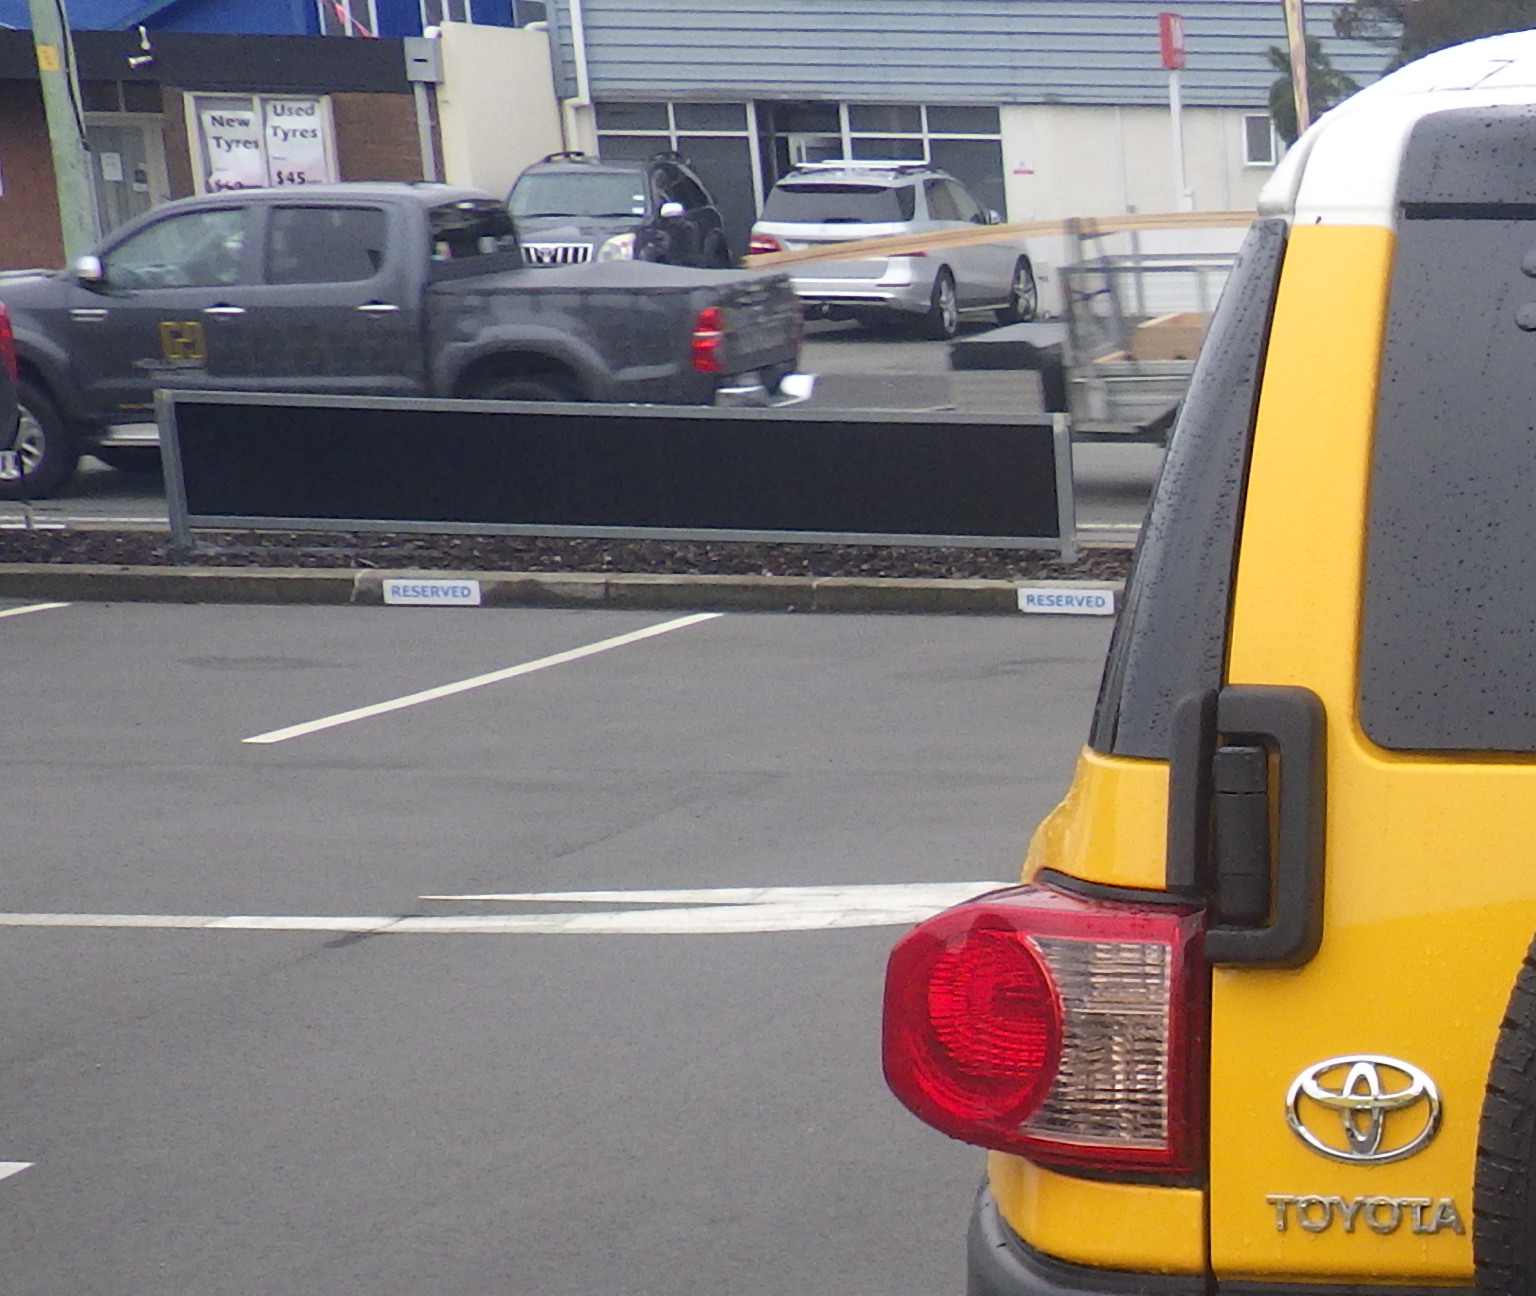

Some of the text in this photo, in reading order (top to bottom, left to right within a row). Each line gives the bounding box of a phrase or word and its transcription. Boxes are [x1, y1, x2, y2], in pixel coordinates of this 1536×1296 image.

[272, 103, 315, 117] Used
[210, 114, 250, 128] New
[270, 124, 318, 142] Tyres
[276, 170, 306, 185] $45
[391, 584, 472, 599] RESERVED
[1026, 593, 1106, 608] RESERVED
[1265, 1193, 1467, 1236] TOYOTA
